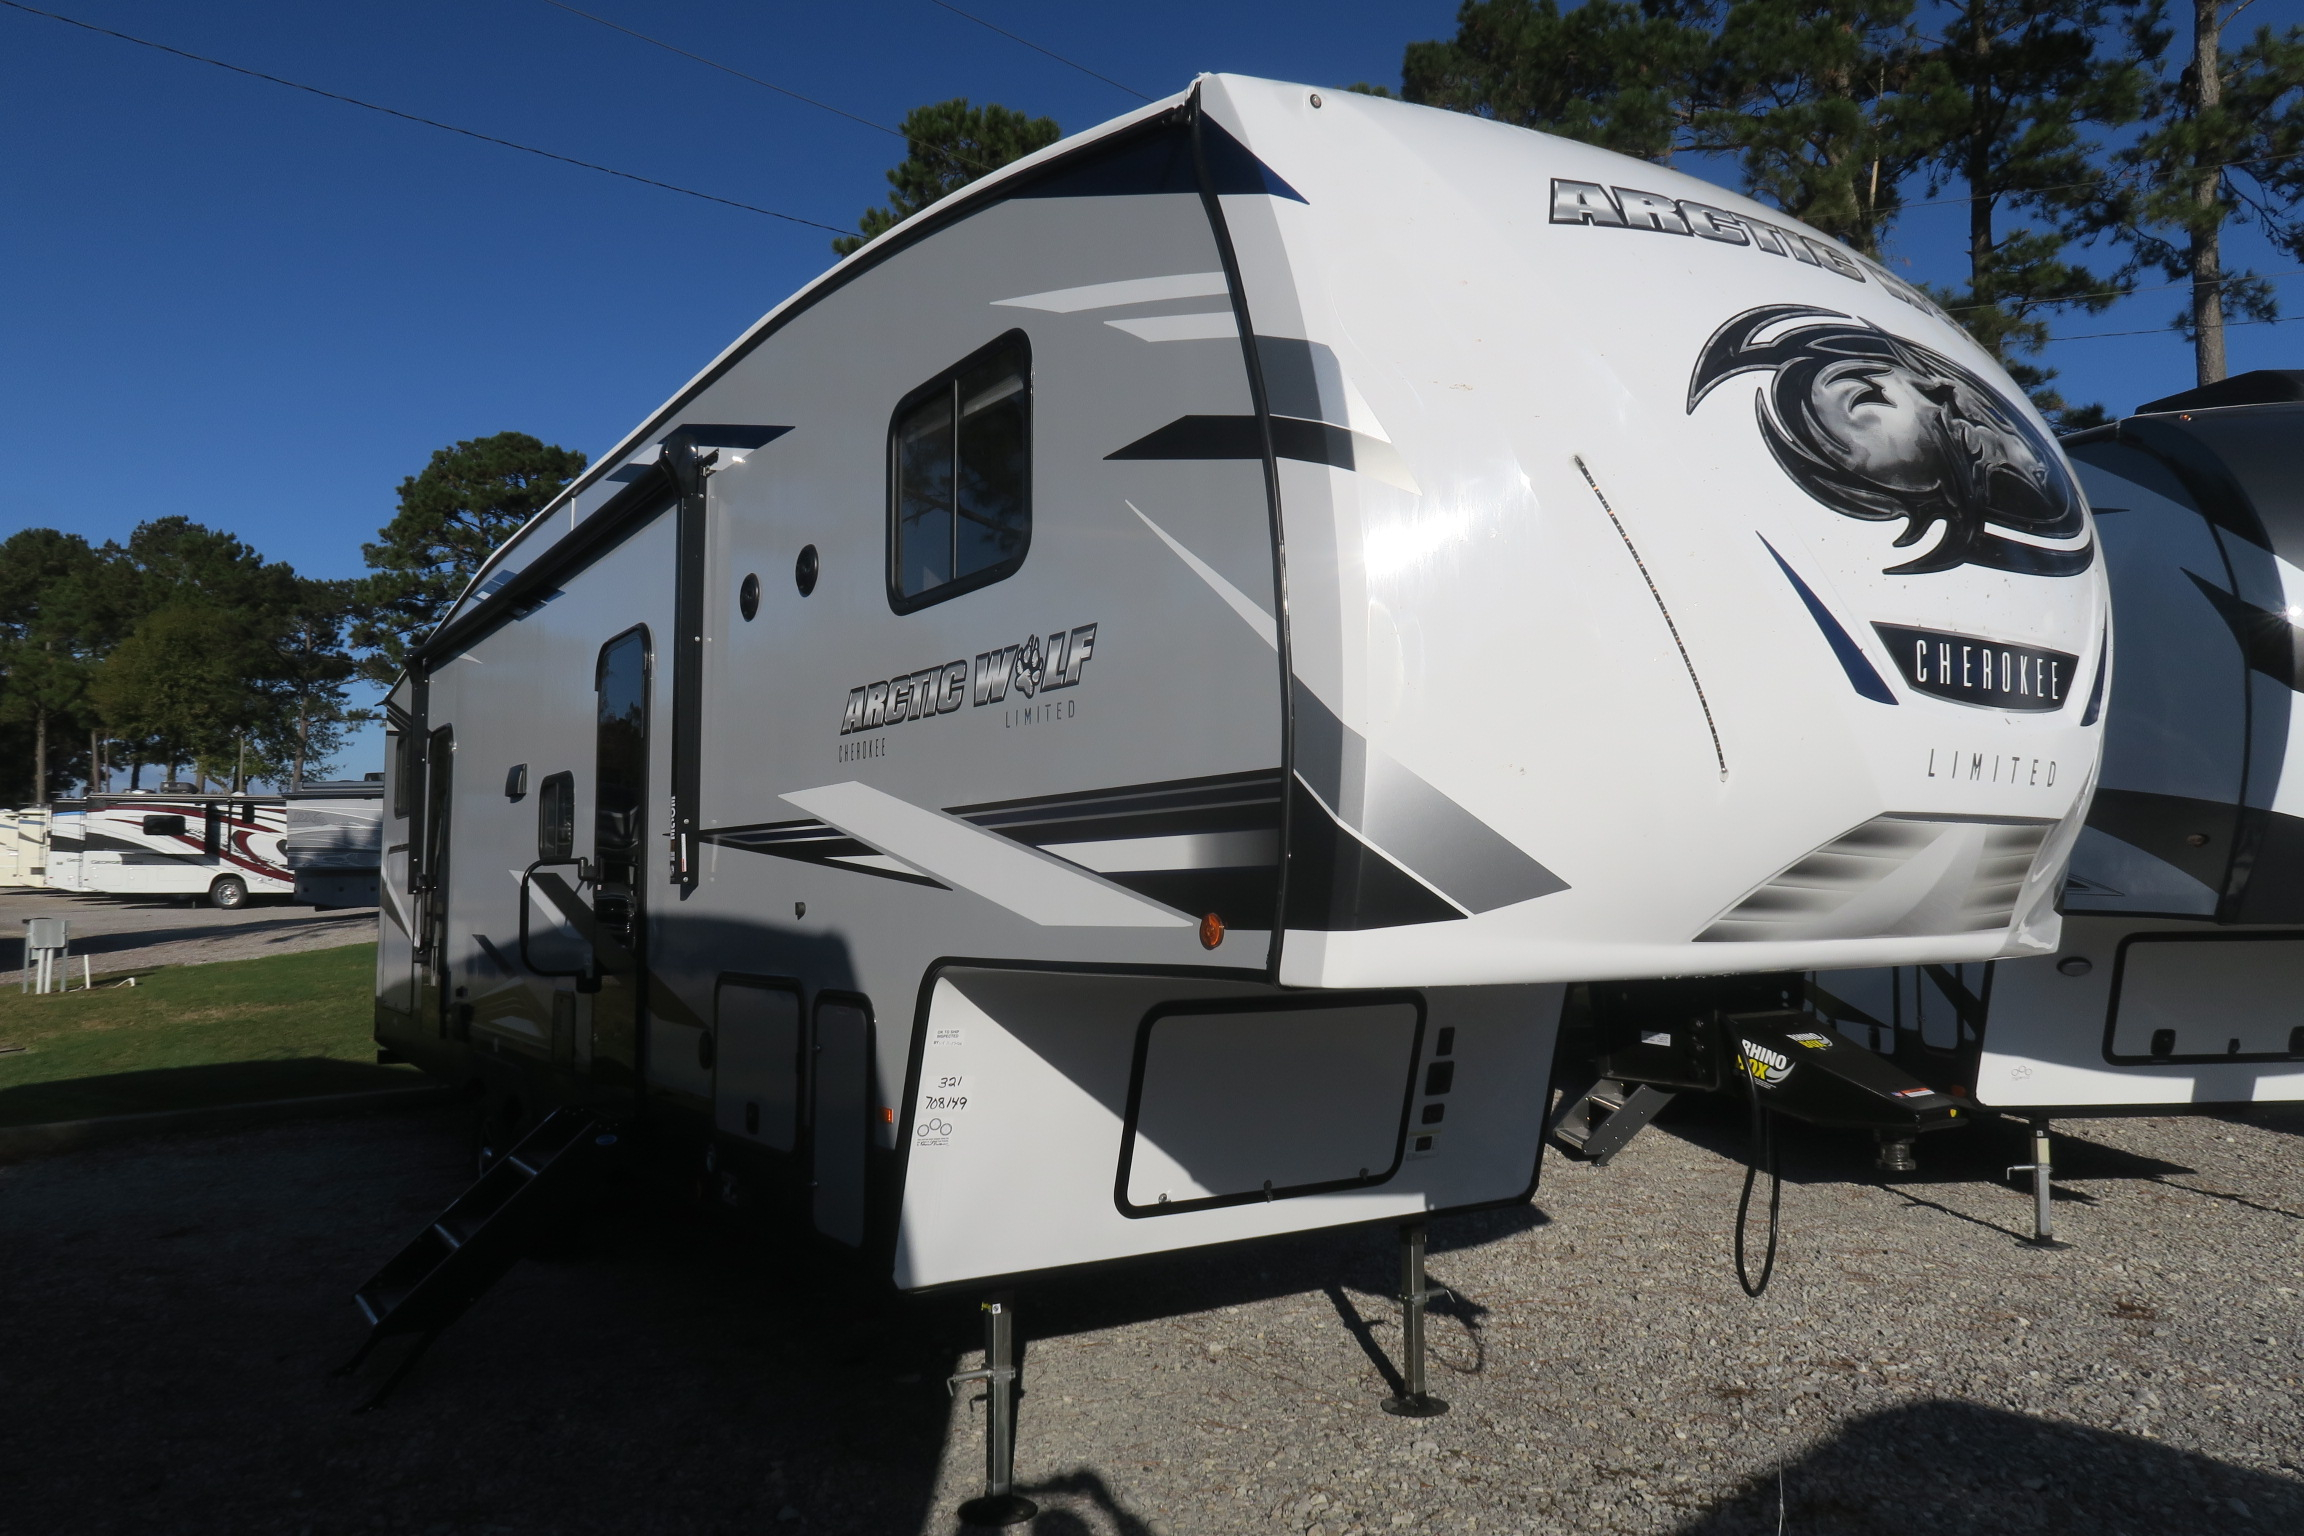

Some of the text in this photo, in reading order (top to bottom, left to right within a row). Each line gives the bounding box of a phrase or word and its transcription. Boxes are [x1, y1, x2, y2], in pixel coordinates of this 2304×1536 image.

[1549, 177, 1866, 283] ARCTIC
[1916, 639, 2059, 700] CHEROKEE
[840, 659, 967, 735] ARCTIC
[1005, 699, 1075, 729] LIMITED
[838, 737, 886, 764] CHEROKEE
[1927, 748, 2057, 788] LIMITED
[1741, 1038, 1787, 1070] RHINO
[938, 1076, 963, 1089] 321
[925, 1095, 968, 1111] 708149
